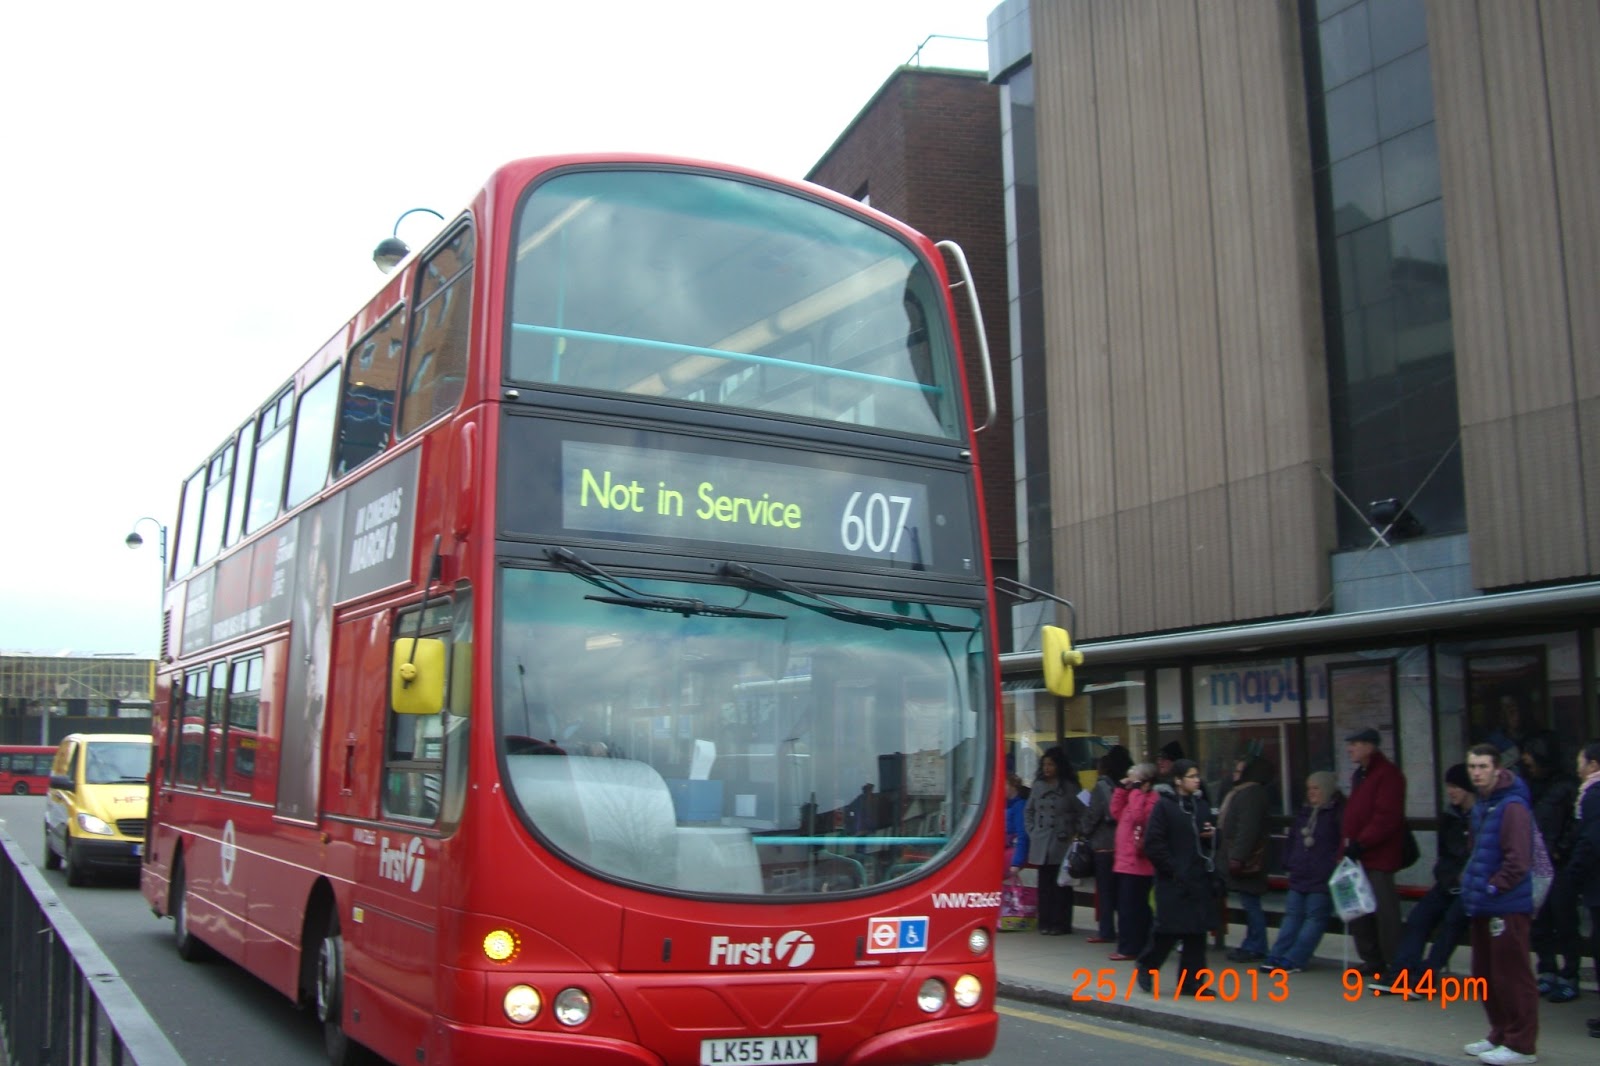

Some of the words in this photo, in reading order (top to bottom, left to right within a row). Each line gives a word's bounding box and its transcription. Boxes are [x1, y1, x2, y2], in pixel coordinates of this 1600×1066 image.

[580, 468, 644, 514] Not
[657, 481, 683, 517] in
[696, 482, 801, 530] Service
[840, 490, 912, 554] 607
[1210, 659, 1327, 713] mapln
[379, 836, 406, 884] First
[709, 936, 772, 966] First
[711, 1041, 764, 1063] LK55
[770, 1039, 809, 1060] AAX
